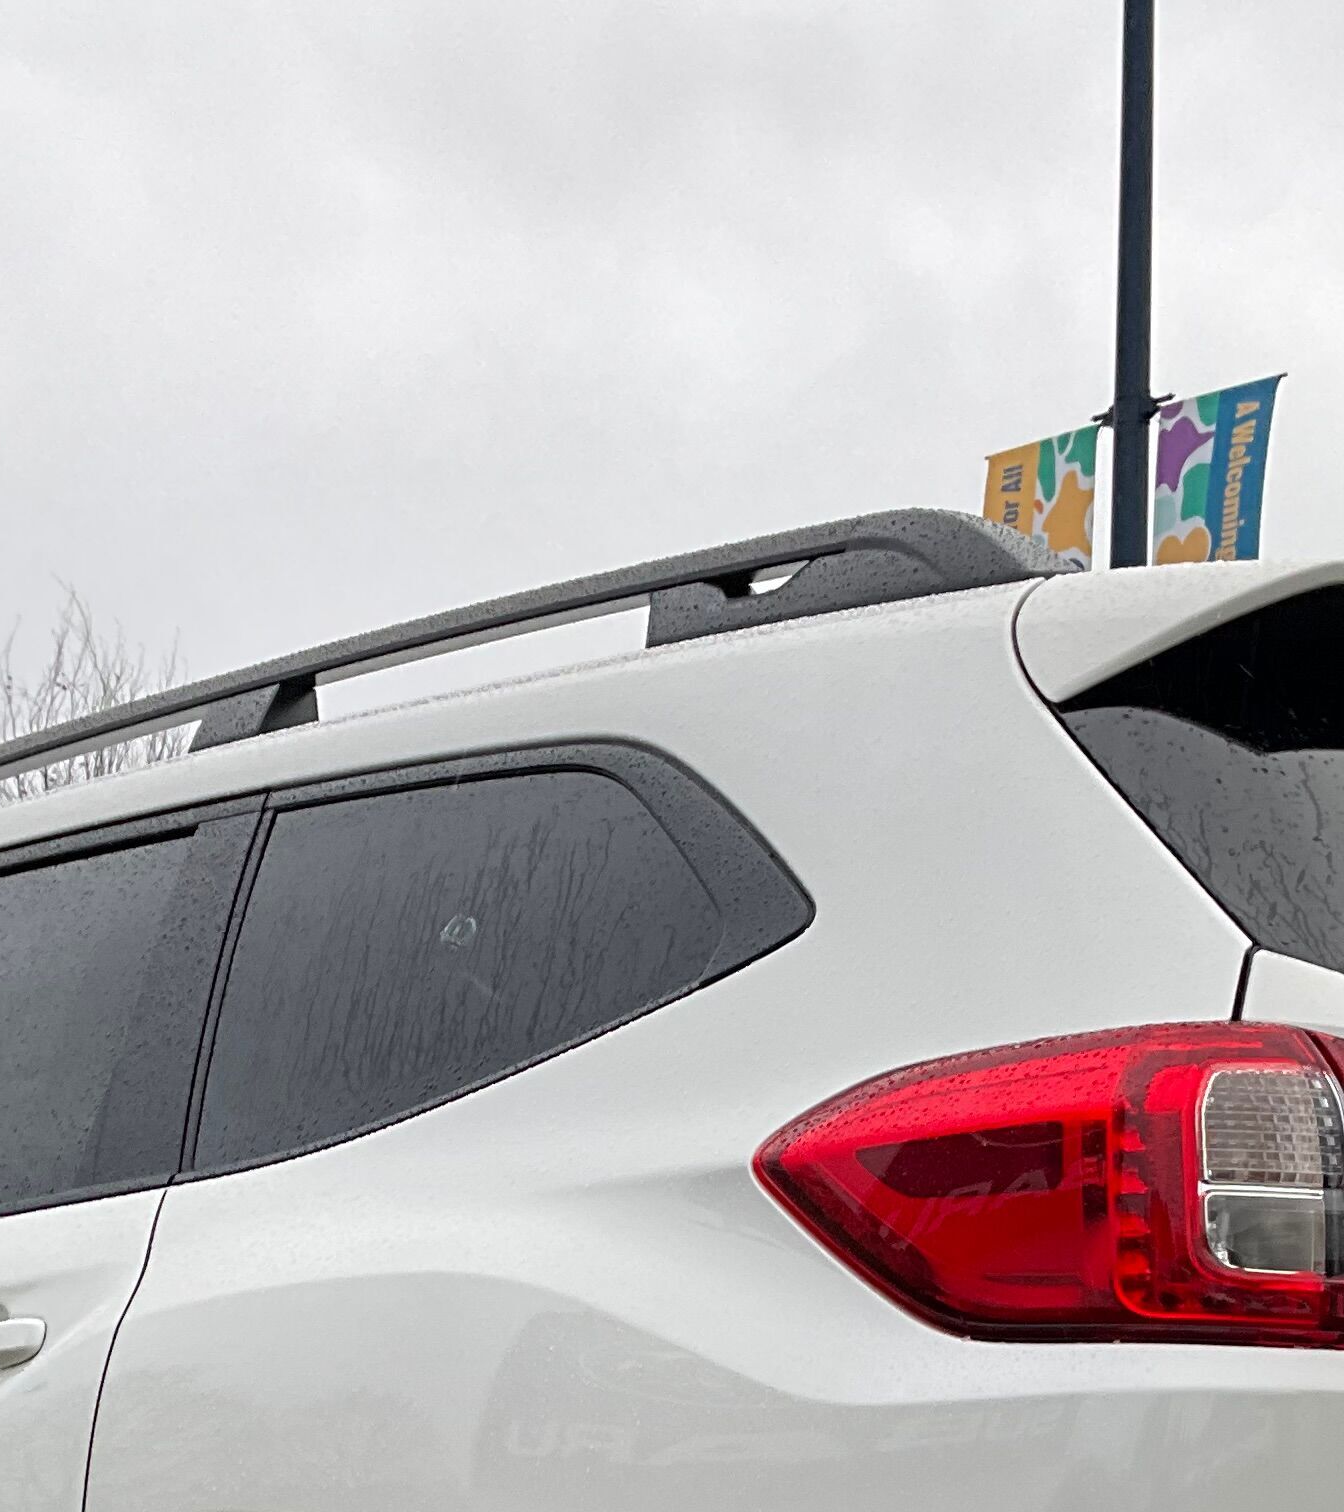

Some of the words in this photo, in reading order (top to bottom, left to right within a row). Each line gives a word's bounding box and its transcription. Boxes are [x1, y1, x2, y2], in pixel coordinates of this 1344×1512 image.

[1235, 401, 1260, 419] A
[1001, 465, 1023, 492] All
[1215, 419, 1256, 561] Welcoming
[1002, 500, 1020, 529] or
